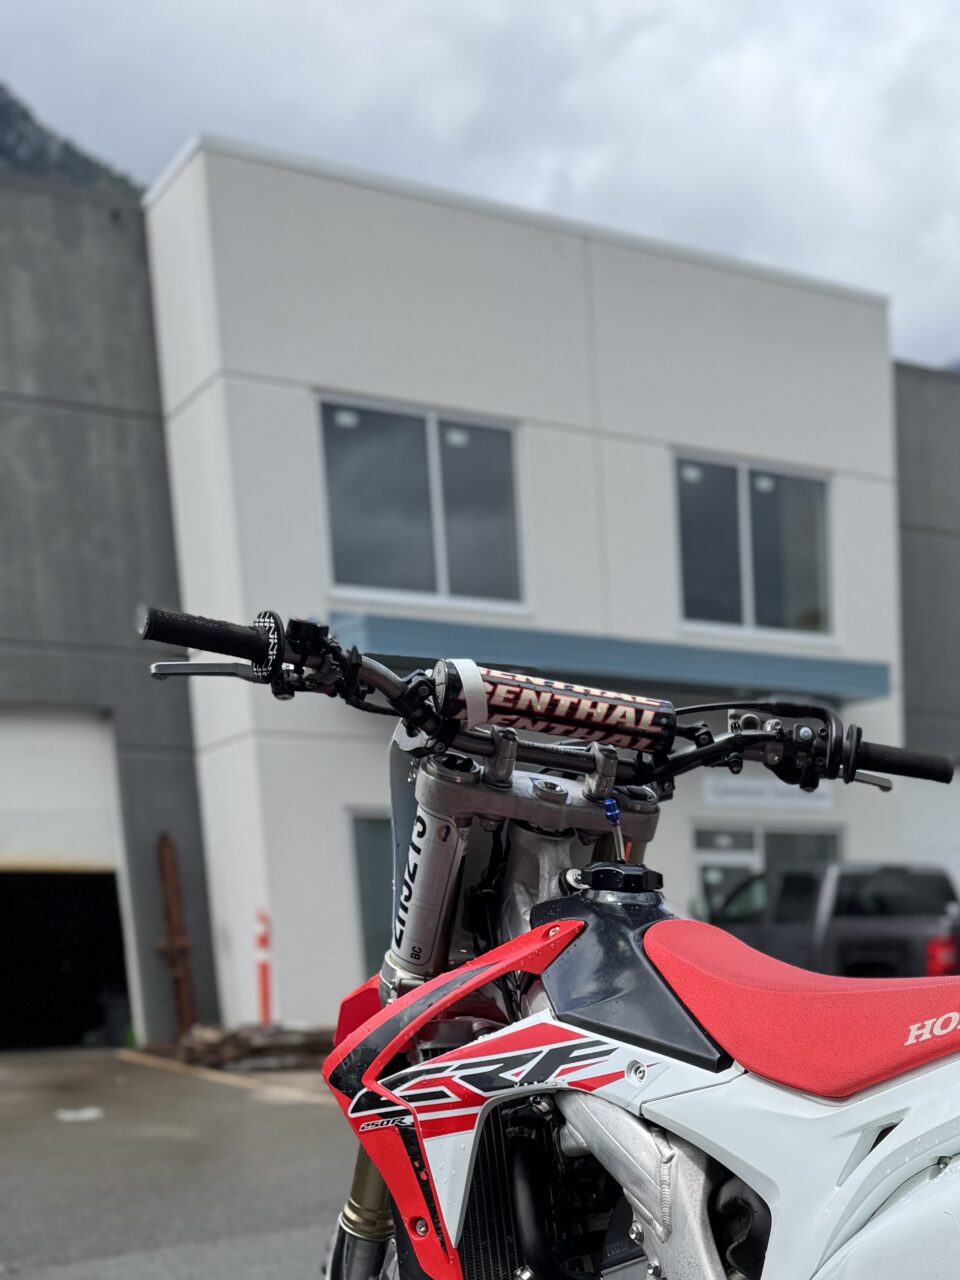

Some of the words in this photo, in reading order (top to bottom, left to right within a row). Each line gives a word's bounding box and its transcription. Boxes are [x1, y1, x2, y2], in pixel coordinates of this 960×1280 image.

[410, 945, 422, 960] BC
[350, 1039, 620, 1115] CRF
[360, 1117, 407, 1131] 250R
